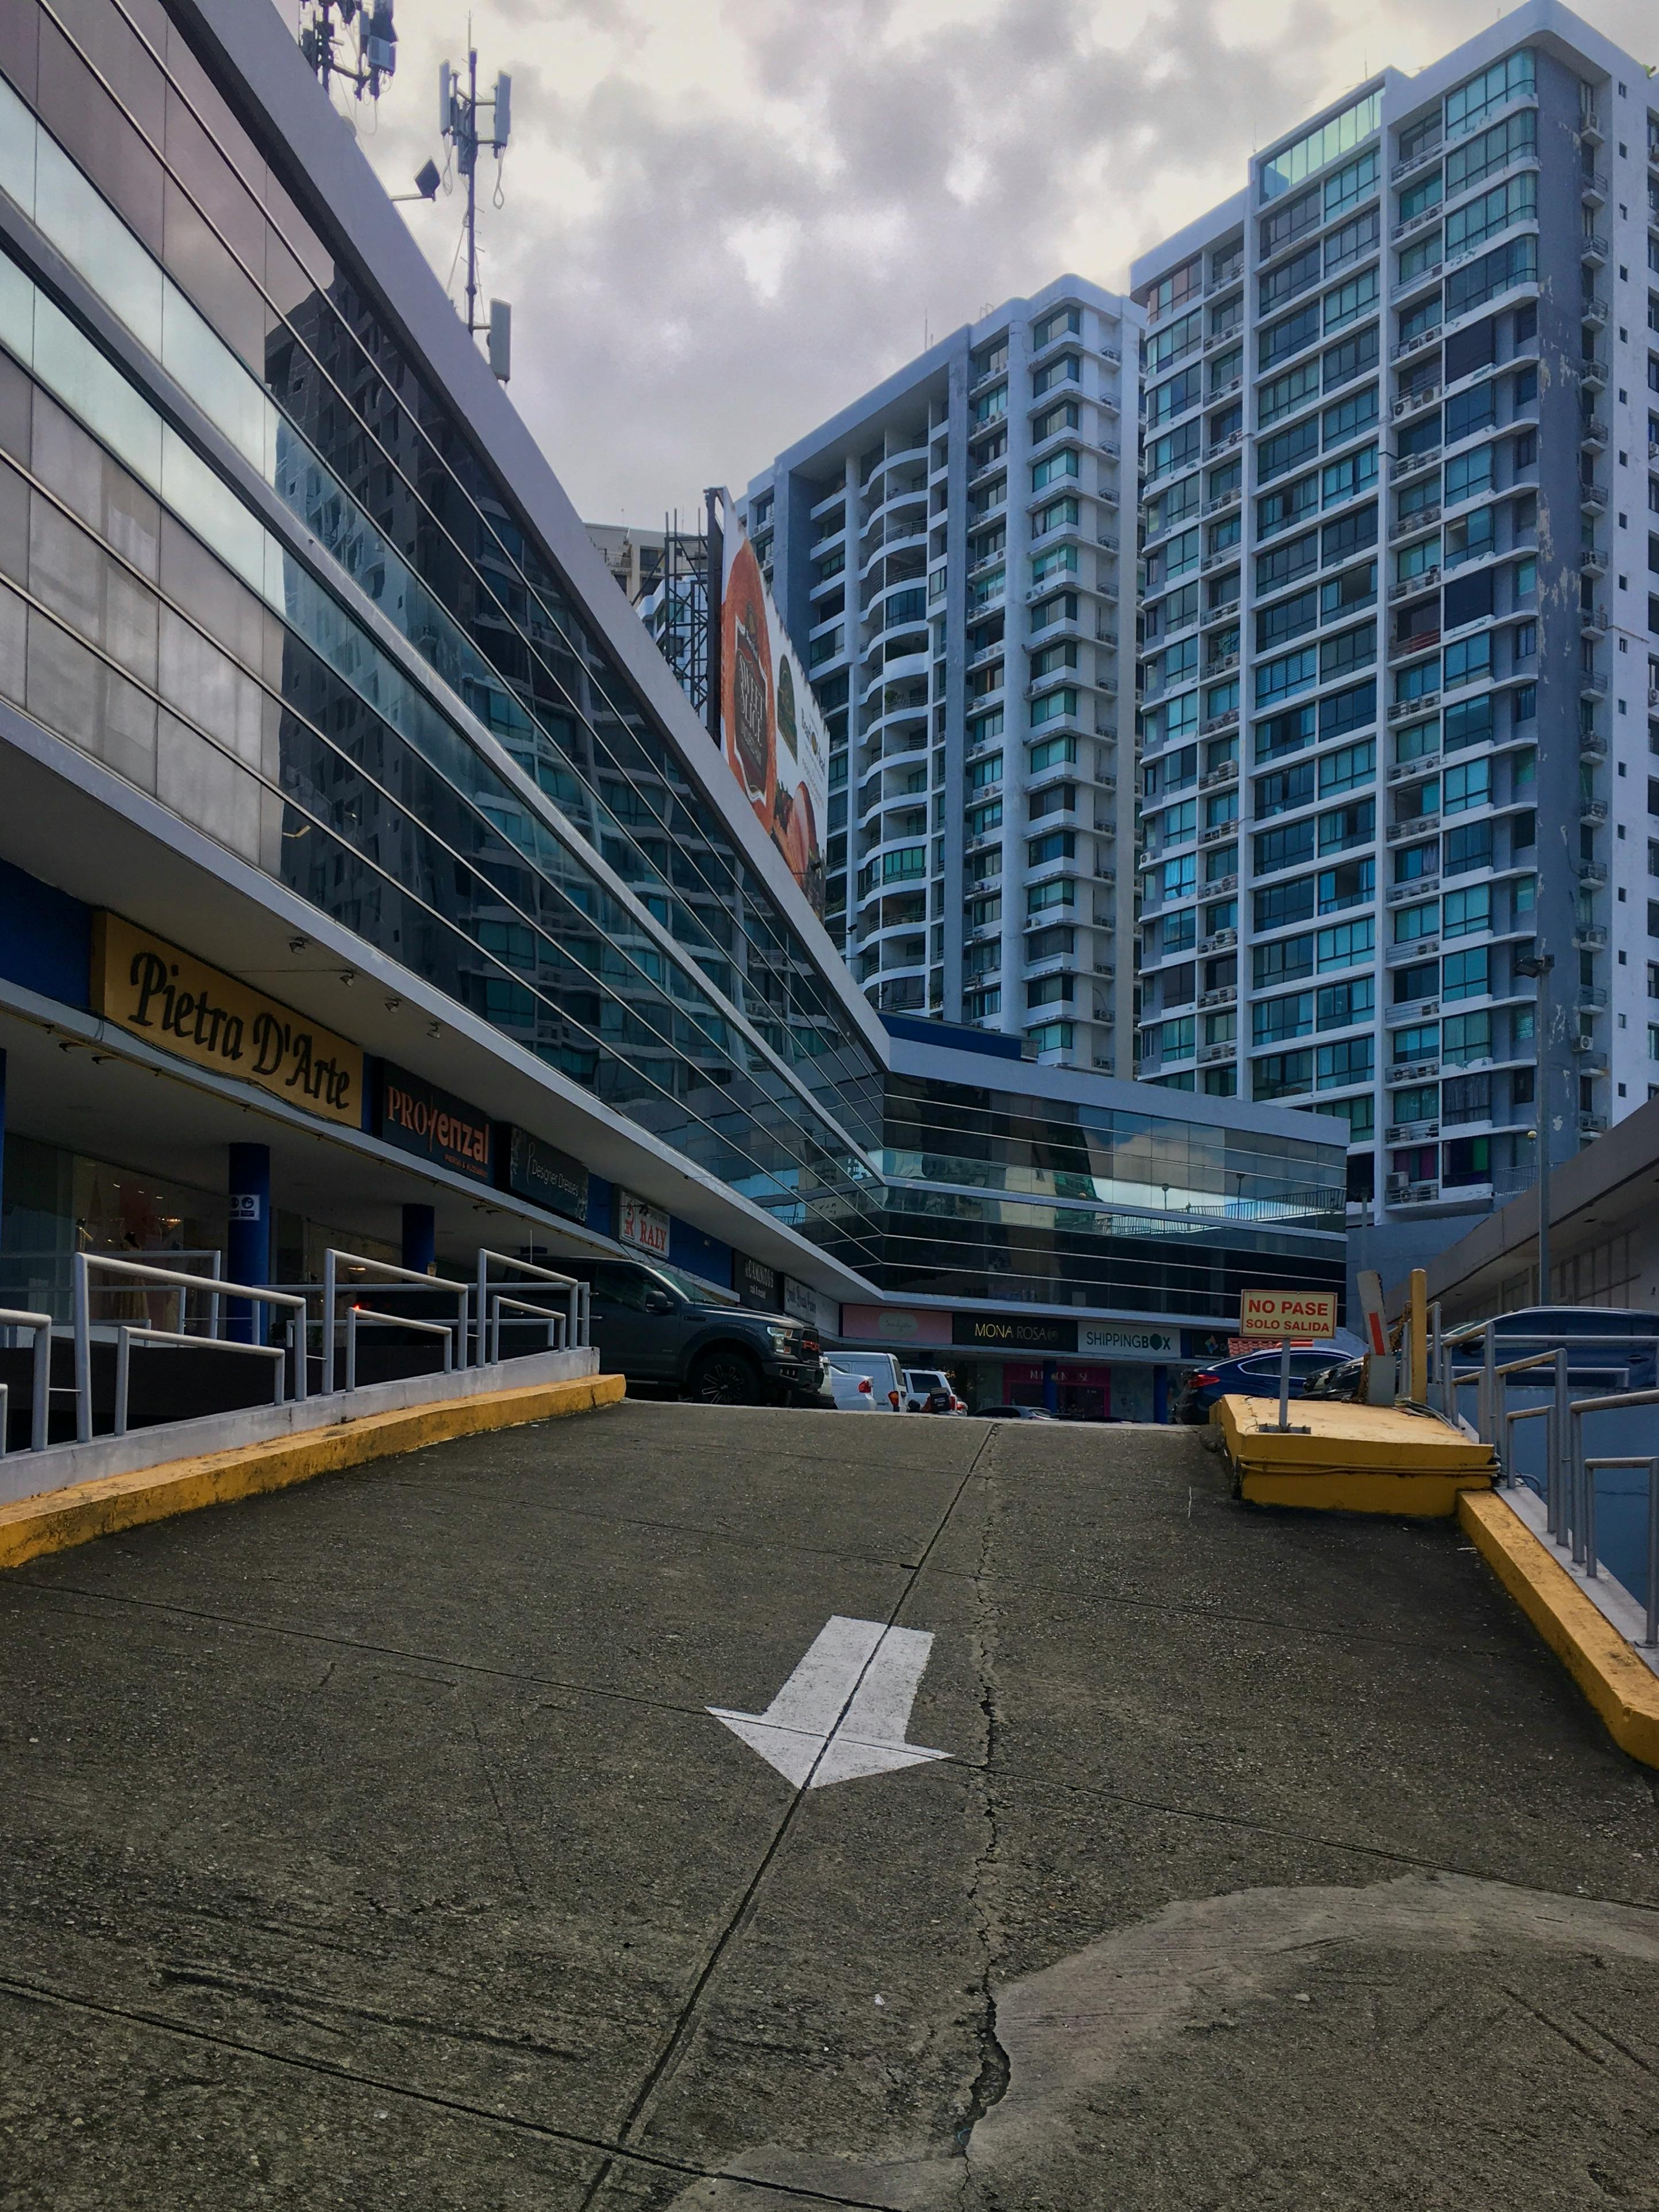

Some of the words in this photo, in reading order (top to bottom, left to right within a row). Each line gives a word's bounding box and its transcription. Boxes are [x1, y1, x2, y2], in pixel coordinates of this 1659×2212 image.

[128, 952, 244, 1061] Pietra
[252, 1012, 350, 1110] D'Arte
[532, 1159, 558, 1184] Designer
[558, 1173, 578, 1196] Dresses
[1248, 1299, 1275, 1314] NO
[1281, 1301, 1329, 1316] PASE
[975, 1323, 1013, 1338] MONA
[1017, 1326, 1047, 1340] ROSA
[1246, 1319, 1280, 1329] SOLO
[1284, 1321, 1329, 1332] SALIDA
